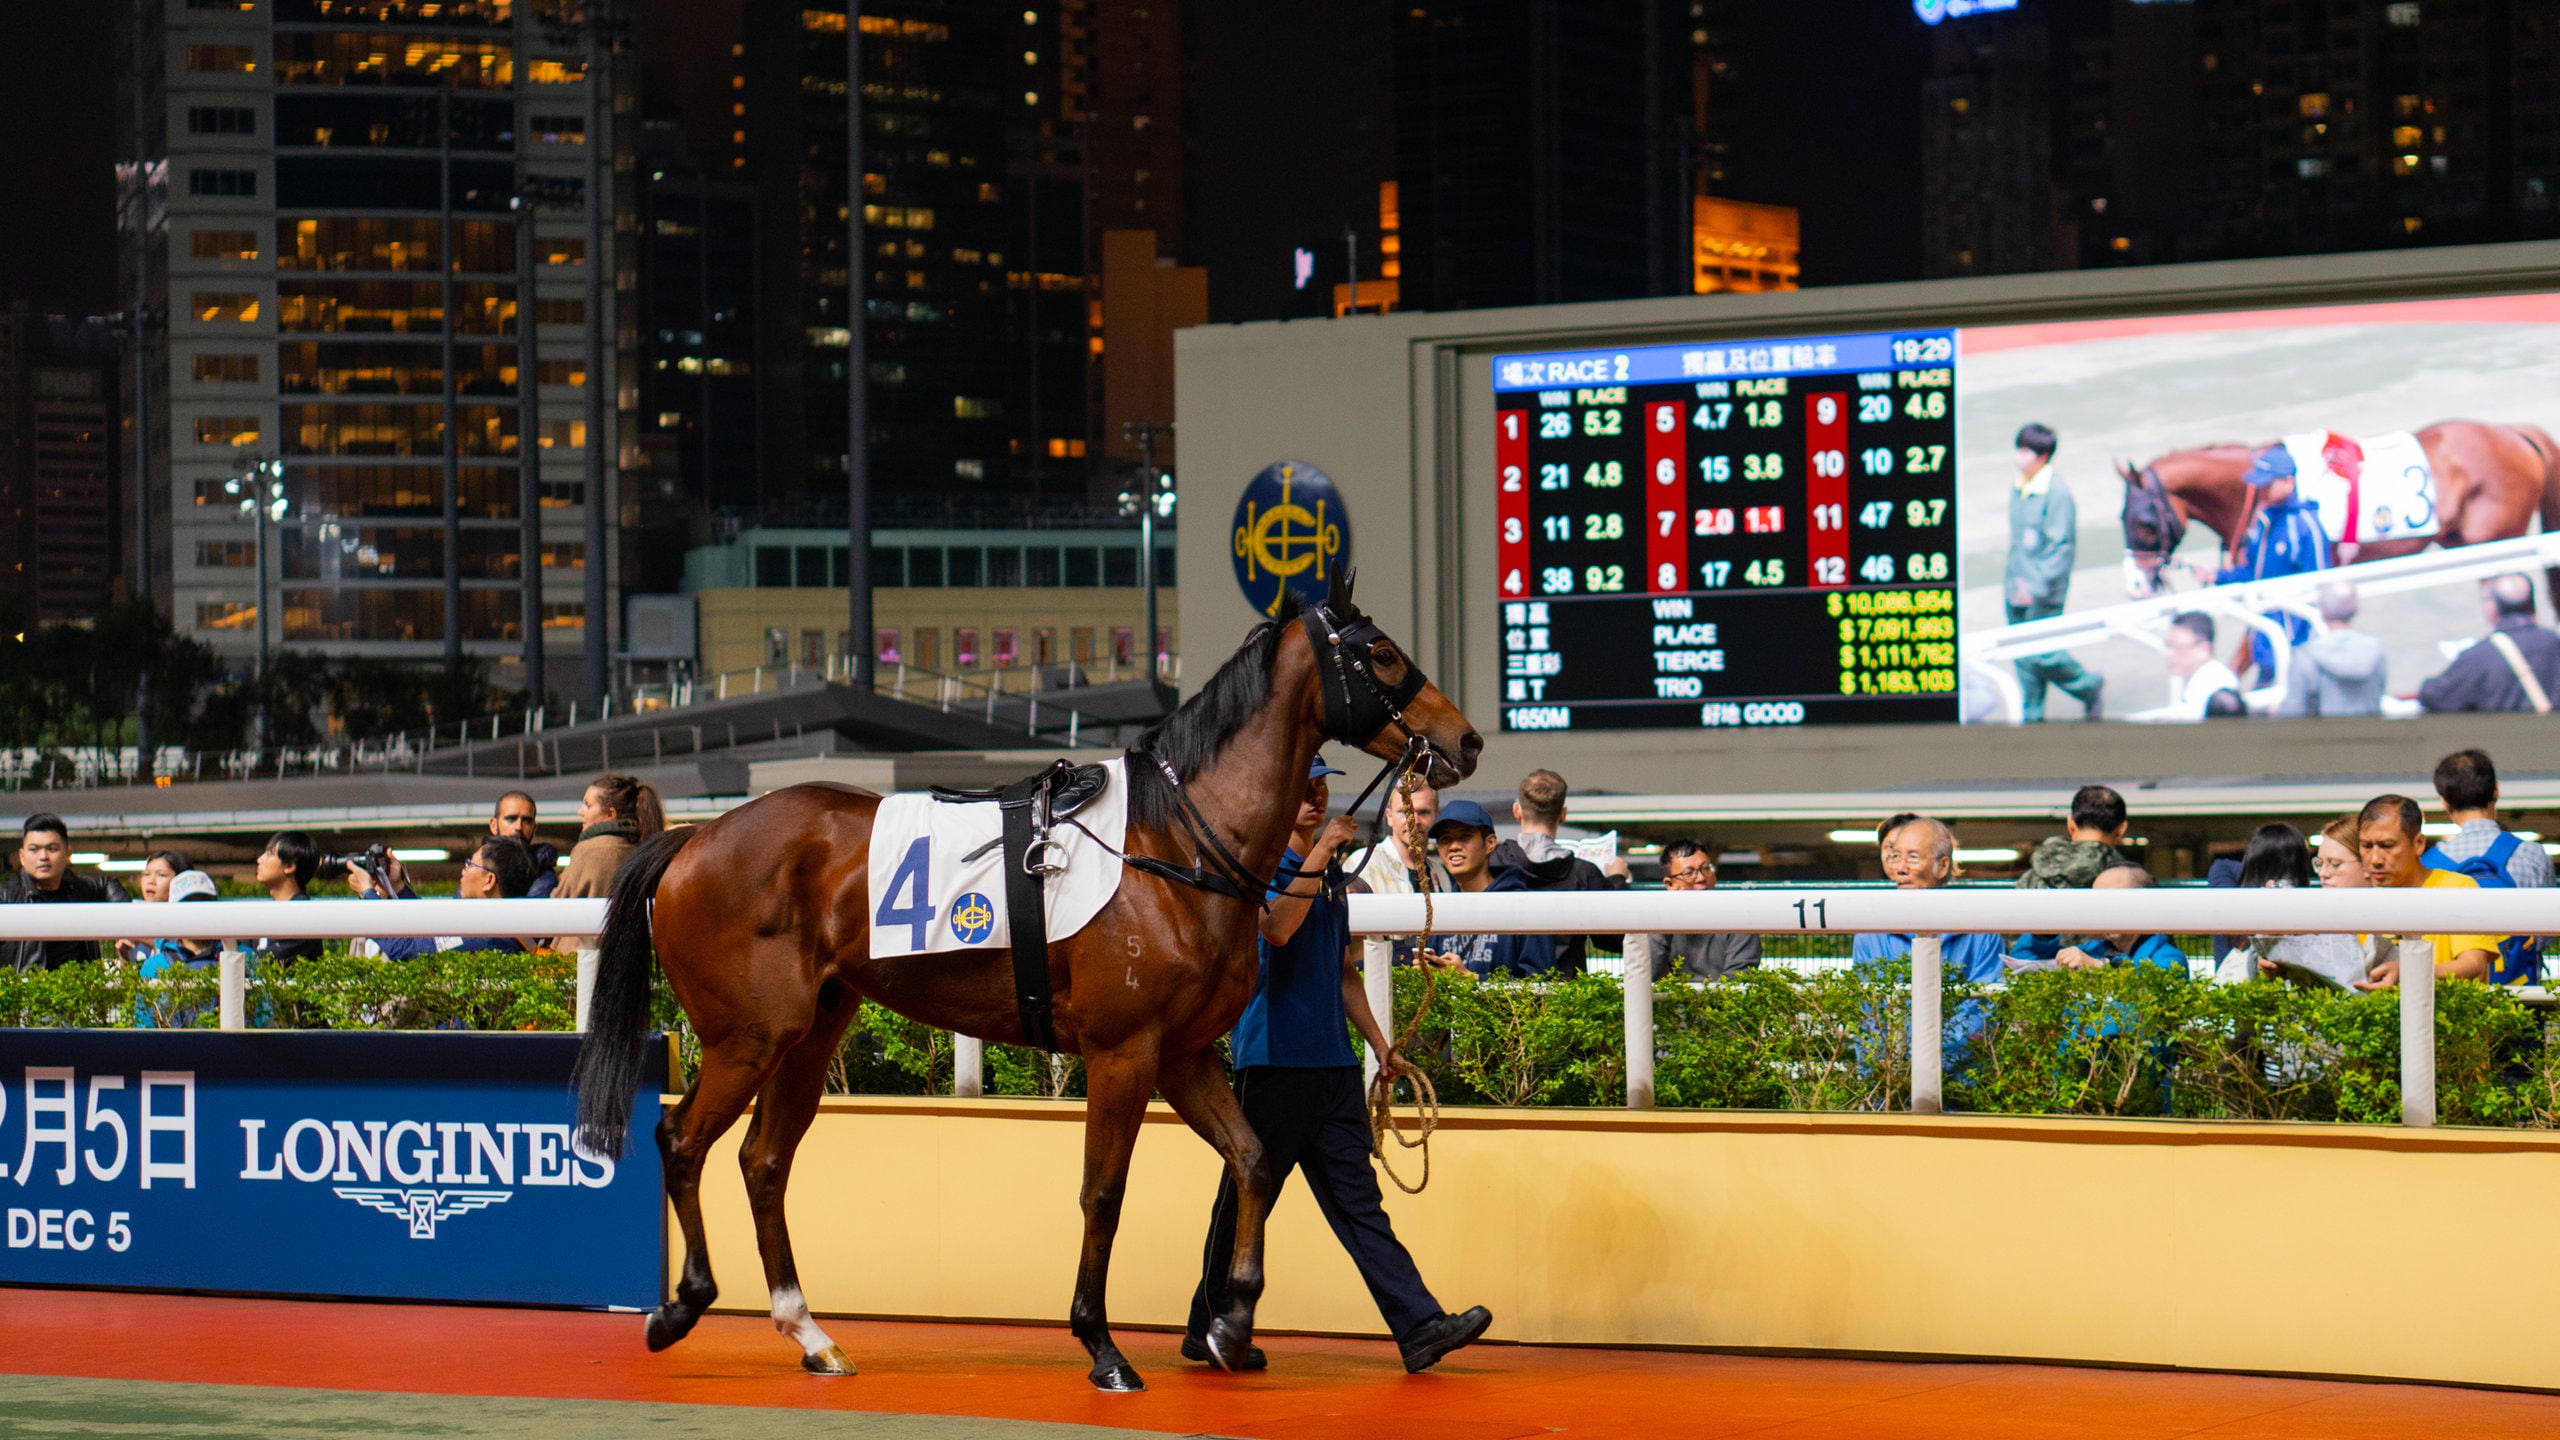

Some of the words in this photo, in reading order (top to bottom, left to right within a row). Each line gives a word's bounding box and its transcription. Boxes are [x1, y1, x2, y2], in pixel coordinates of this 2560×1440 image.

[1893, 338, 1951, 362] 19:29
[1549, 360, 1608, 381] RACE
[1615, 356, 1628, 380] 2
[1857, 372, 1892, 390] WIN
[1898, 368, 1951, 388] PLACE
[1539, 390, 1571, 407] WIN
[1577, 387, 1627, 405] PLACE
[1696, 381, 1729, 399] WIN
[1736, 377, 1788, 397] PLACE
[1657, 406, 1674, 432] 5
[1693, 403, 1733, 430] 4.7
[1744, 400, 1783, 427] 1.8
[1817, 398, 1836, 424] 9
[1859, 394, 1892, 422] 20
[1904, 391, 1946, 419] 4.6
[1504, 415, 1517, 439] 1
[1540, 412, 1571, 438] 26
[1584, 409, 1622, 436] 5.2
[1657, 458, 1675, 484] 6
[1699, 456, 1730, 482] 15
[1744, 453, 1783, 481] 3.8
[1813, 450, 1844, 477] 10
[1861, 448, 1893, 475] 10
[1906, 445, 1946, 474] 2.7
[1504, 466, 1521, 491] 2
[1541, 464, 1569, 490] 21
[1584, 461, 1623, 487] 4.8
[2403, 465, 2433, 529] 3
[1505, 518, 1522, 543] 3
[1543, 516, 1570, 541] 11
[1585, 513, 1623, 540] 2.8
[1658, 511, 1675, 536] 7
[1696, 509, 1733, 534] 2.0
[1746, 507, 1780, 531] 1.1
[1814, 504, 1841, 530] 11
[1859, 501, 1893, 528] 47
[1906, 499, 1947, 527] 9.7
[1504, 569, 1522, 594] 4
[1542, 567, 1574, 593] 38
[1586, 565, 1624, 592] 9.2
[1658, 563, 1676, 589] 8
[1701, 561, 1731, 587] 17
[1744, 559, 1785, 586] 4.5
[1815, 556, 1845, 583] 12
[1860, 555, 1894, 582] 46
[1907, 552, 1948, 580] 6.8
[1652, 598, 1693, 619] WIN
[1653, 623, 1717, 646] PLACE
[1654, 649, 1725, 672] TIERCE
[1654, 676, 1702, 698] TRIO
[1507, 706, 1570, 729] 1650M
[1743, 702, 1804, 724] GOOD
[875, 835, 936, 951] 4
[1792, 898, 1827, 929] 11
[1126, 935, 1141, 958] 5
[1125, 966, 1139, 990] 4
[240, 1118, 616, 1189] LONGINES
[7, 1208, 96, 1251] DEC
[106, 1211, 132, 1252] 5
